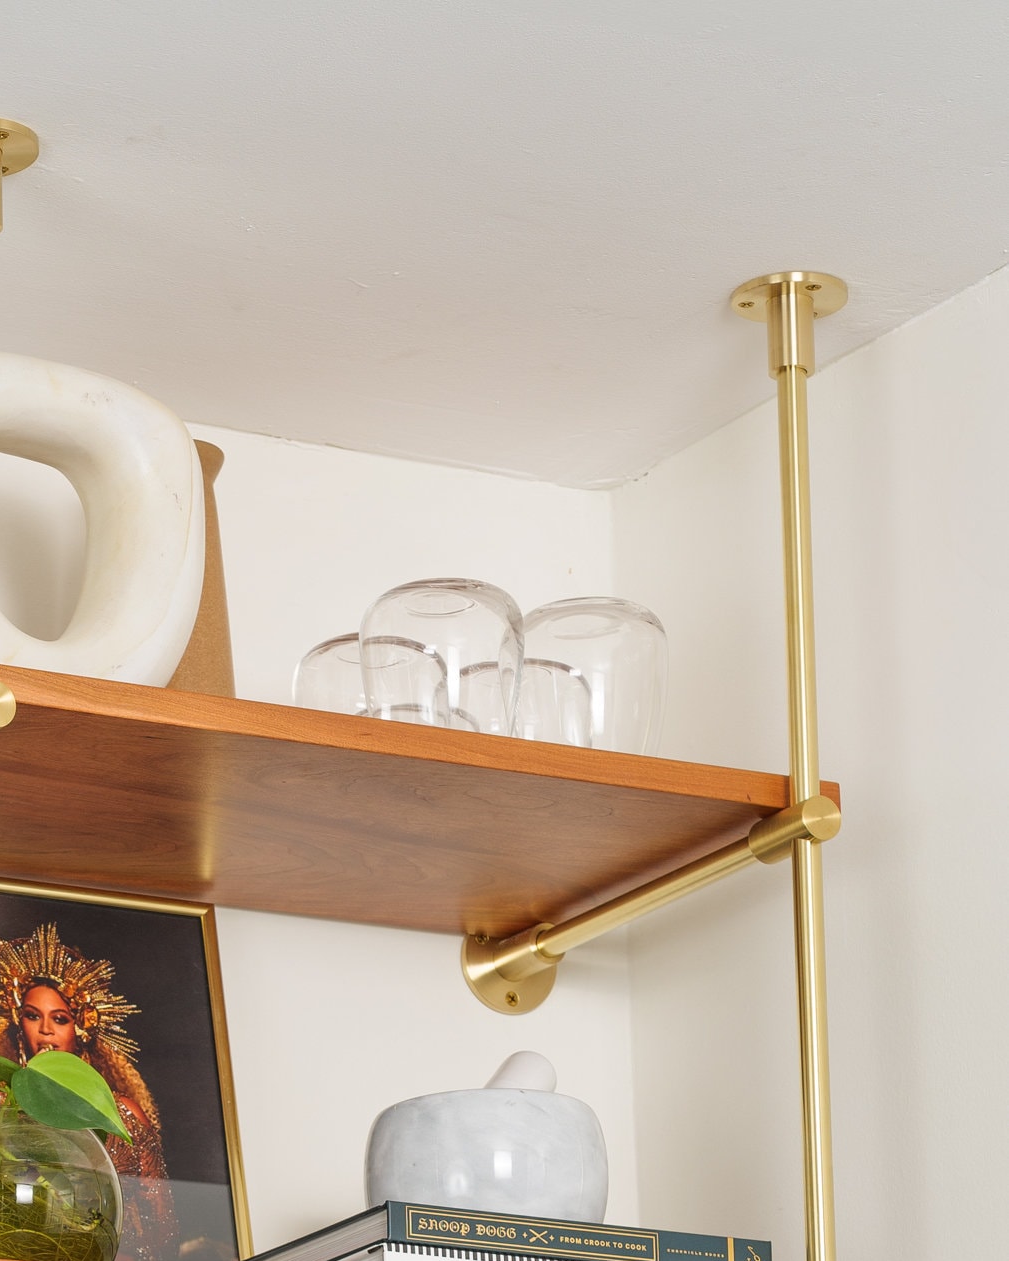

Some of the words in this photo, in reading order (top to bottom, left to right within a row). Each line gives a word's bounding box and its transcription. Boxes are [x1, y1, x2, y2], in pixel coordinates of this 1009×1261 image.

[418, 1217, 470, 1236] SNOOP
[475, 1223, 517, 1239] DOGG
[559, 1236, 582, 1244] FROM
[584, 1239, 611, 1248] CROOK
[625, 1243, 647, 1251] COOK
